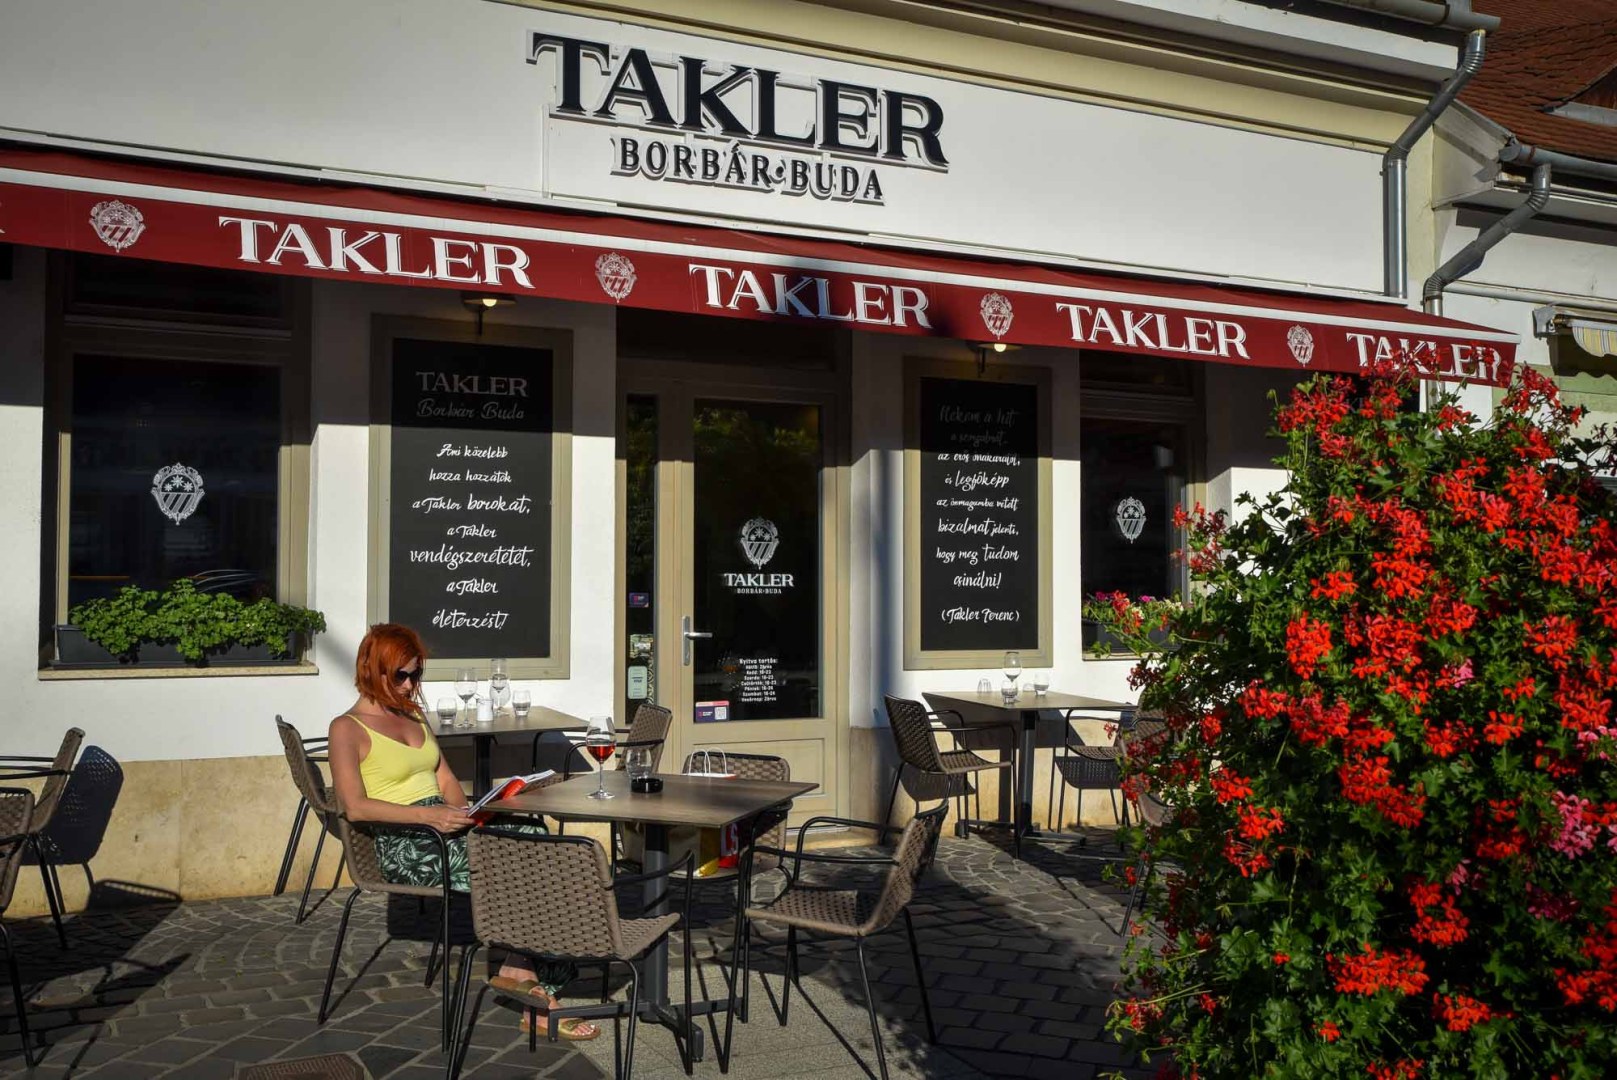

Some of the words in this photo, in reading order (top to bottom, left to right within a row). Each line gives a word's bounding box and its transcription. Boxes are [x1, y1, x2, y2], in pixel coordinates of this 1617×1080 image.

[530, 33, 949, 168] TAKLER
[219, 215, 535, 289] TAKLER
[688, 263, 932, 328] TAKLER
[1055, 302, 1250, 360] TAKLER
[415, 371, 529, 398] TAKLER
[480, 401, 525, 420] Buda
[436, 443, 461, 458] Ami
[464, 445, 509, 459] közelebb
[937, 453, 950, 461] az
[429, 468, 461, 481] hozza
[945, 473, 953, 485] és
[955, 470, 1010, 491] legfőképp
[412, 501, 421, 509] a
[421, 497, 462, 514] Takler
[467, 493, 532, 514] borokat,
[936, 499, 949, 507] az
[997, 497, 1019, 511] vetett
[447, 527, 455, 536] a
[455, 524, 498, 539] Takler
[938, 517, 995, 535] bizalmat
[990, 523, 1019, 537] jelenti,
[936, 547, 956, 564] hogy
[958, 550, 979, 565] meg
[981, 543, 1020, 561] tudom
[446, 582, 455, 593] a
[455, 578, 499, 595] Takler
[723, 573, 794, 587] TAKLER
[953, 570, 1002, 589] csinálni!
[941, 606, 980, 624] (Takler
[981, 608, 1020, 624] Ferenc)
